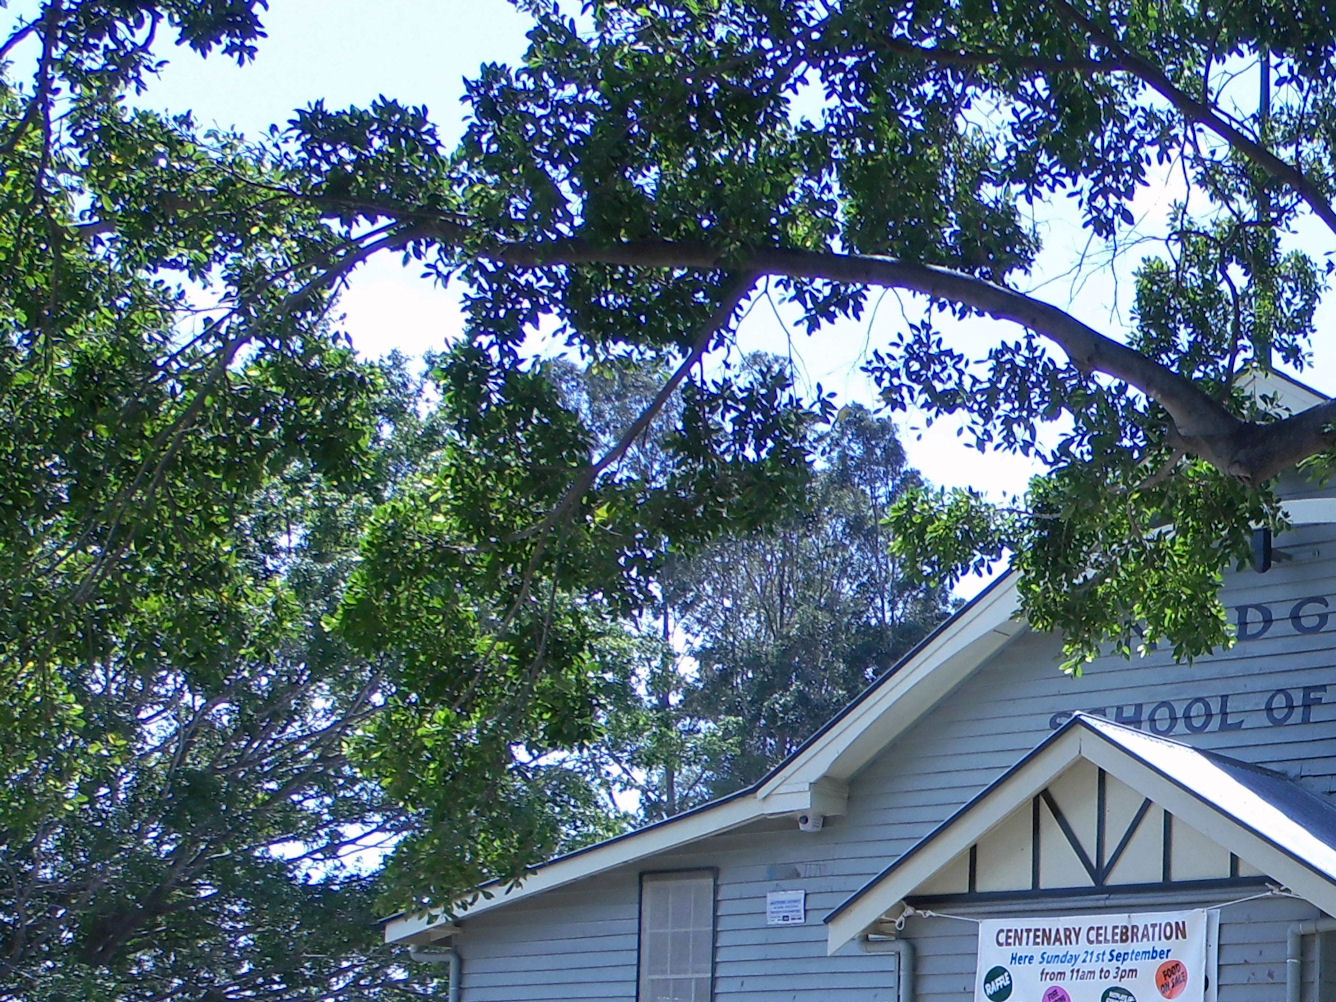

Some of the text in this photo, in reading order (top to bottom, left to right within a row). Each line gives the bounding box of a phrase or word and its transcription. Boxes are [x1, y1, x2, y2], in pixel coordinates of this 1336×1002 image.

[1265, 685, 1328, 727] OF
[995, 920, 1187, 947] CENTENARY CELEBRATION
[1010, 952, 1034, 965] Here
[1039, 950, 1080, 967] Sunday
[1108, 945, 1171, 965] September
[984, 971, 1011, 996] RAFFLE
[1040, 966, 1138, 982] from 11am to 3pm
[1162, 963, 1181, 981] FOOD
